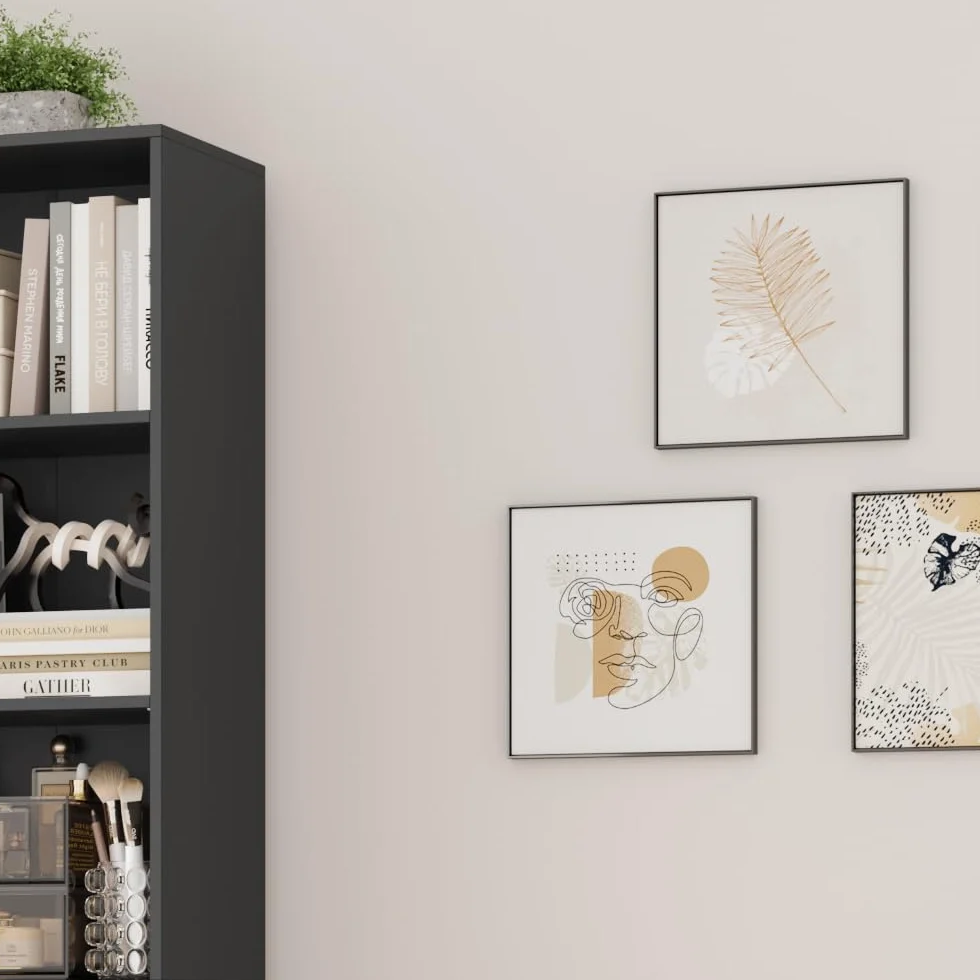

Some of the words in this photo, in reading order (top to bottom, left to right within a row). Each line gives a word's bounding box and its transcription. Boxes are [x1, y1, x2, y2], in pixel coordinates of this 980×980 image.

[94, 261, 108, 278] НЕ
[24, 268, 38, 324] STEPHEN
[20, 325, 33, 373] MARINO
[94, 333, 109, 386] ГОЛОВУ
[54, 355, 66, 393] FLAKE
[23, 627, 71, 636] GALLIANO
[84, 625, 109, 634] DIOR
[35, 659, 86, 669] PASTRY
[92, 657, 128, 668] CLUB
[23, 678, 91, 695] GATHER
